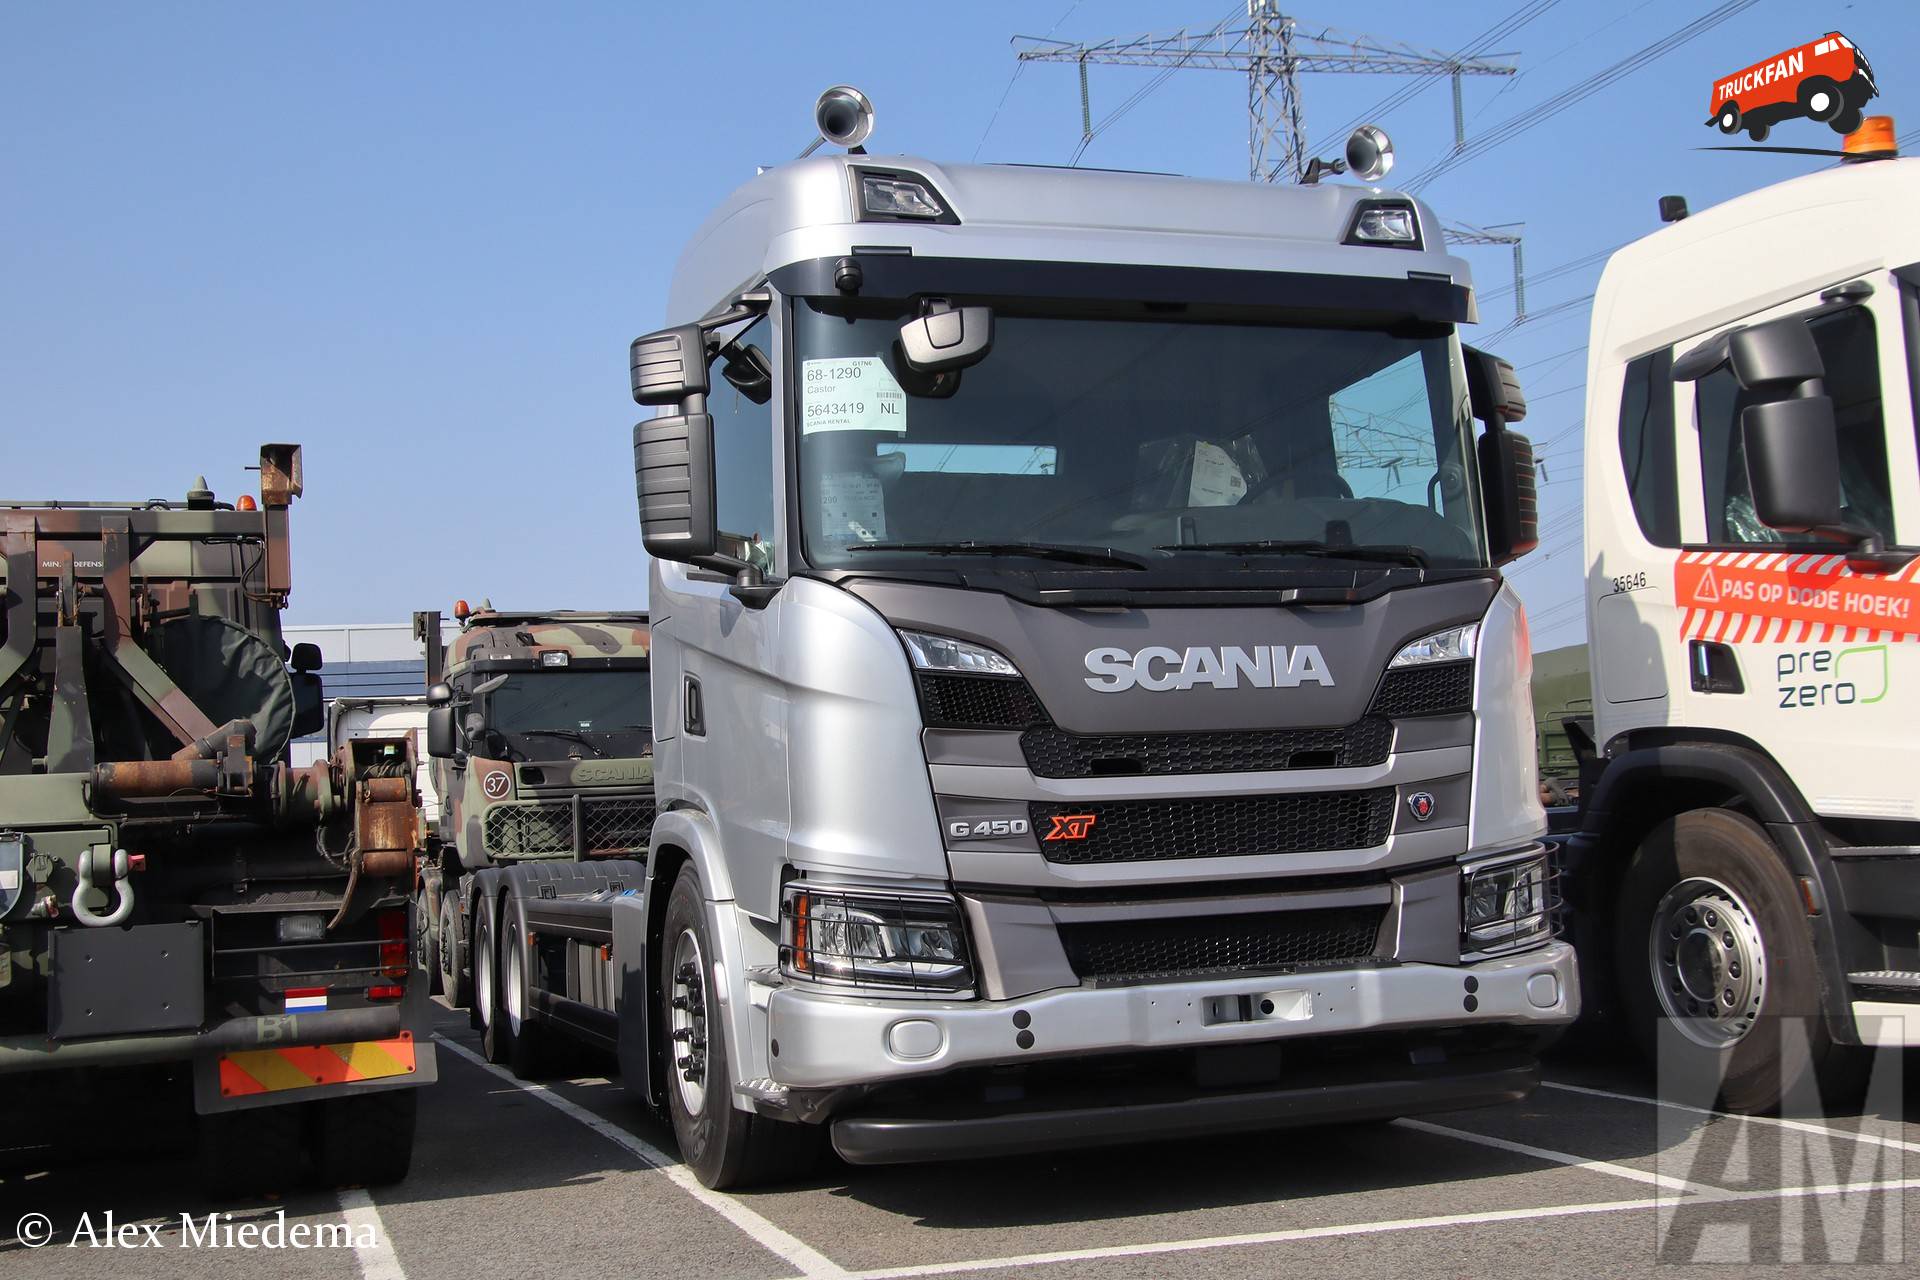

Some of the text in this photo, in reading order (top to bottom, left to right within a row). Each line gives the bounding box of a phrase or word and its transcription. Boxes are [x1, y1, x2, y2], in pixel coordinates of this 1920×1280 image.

[807, 367, 861, 382] 68-1290
[807, 385, 836, 394] Castor
[807, 402, 899, 417] 5643419 NL
[1612, 571, 1647, 593] 35646
[1721, 578, 1910, 619] PAS OP DODE HOEK!
[1084, 644, 1336, 693] SCANIA
[1777, 649, 1832, 682] pre
[1778, 681, 1856, 709] zero
[487, 776, 506, 793] 37
[949, 819, 1029, 837] G 450
[1044, 814, 1096, 842] XT
[256, 1013, 298, 1042] B1
